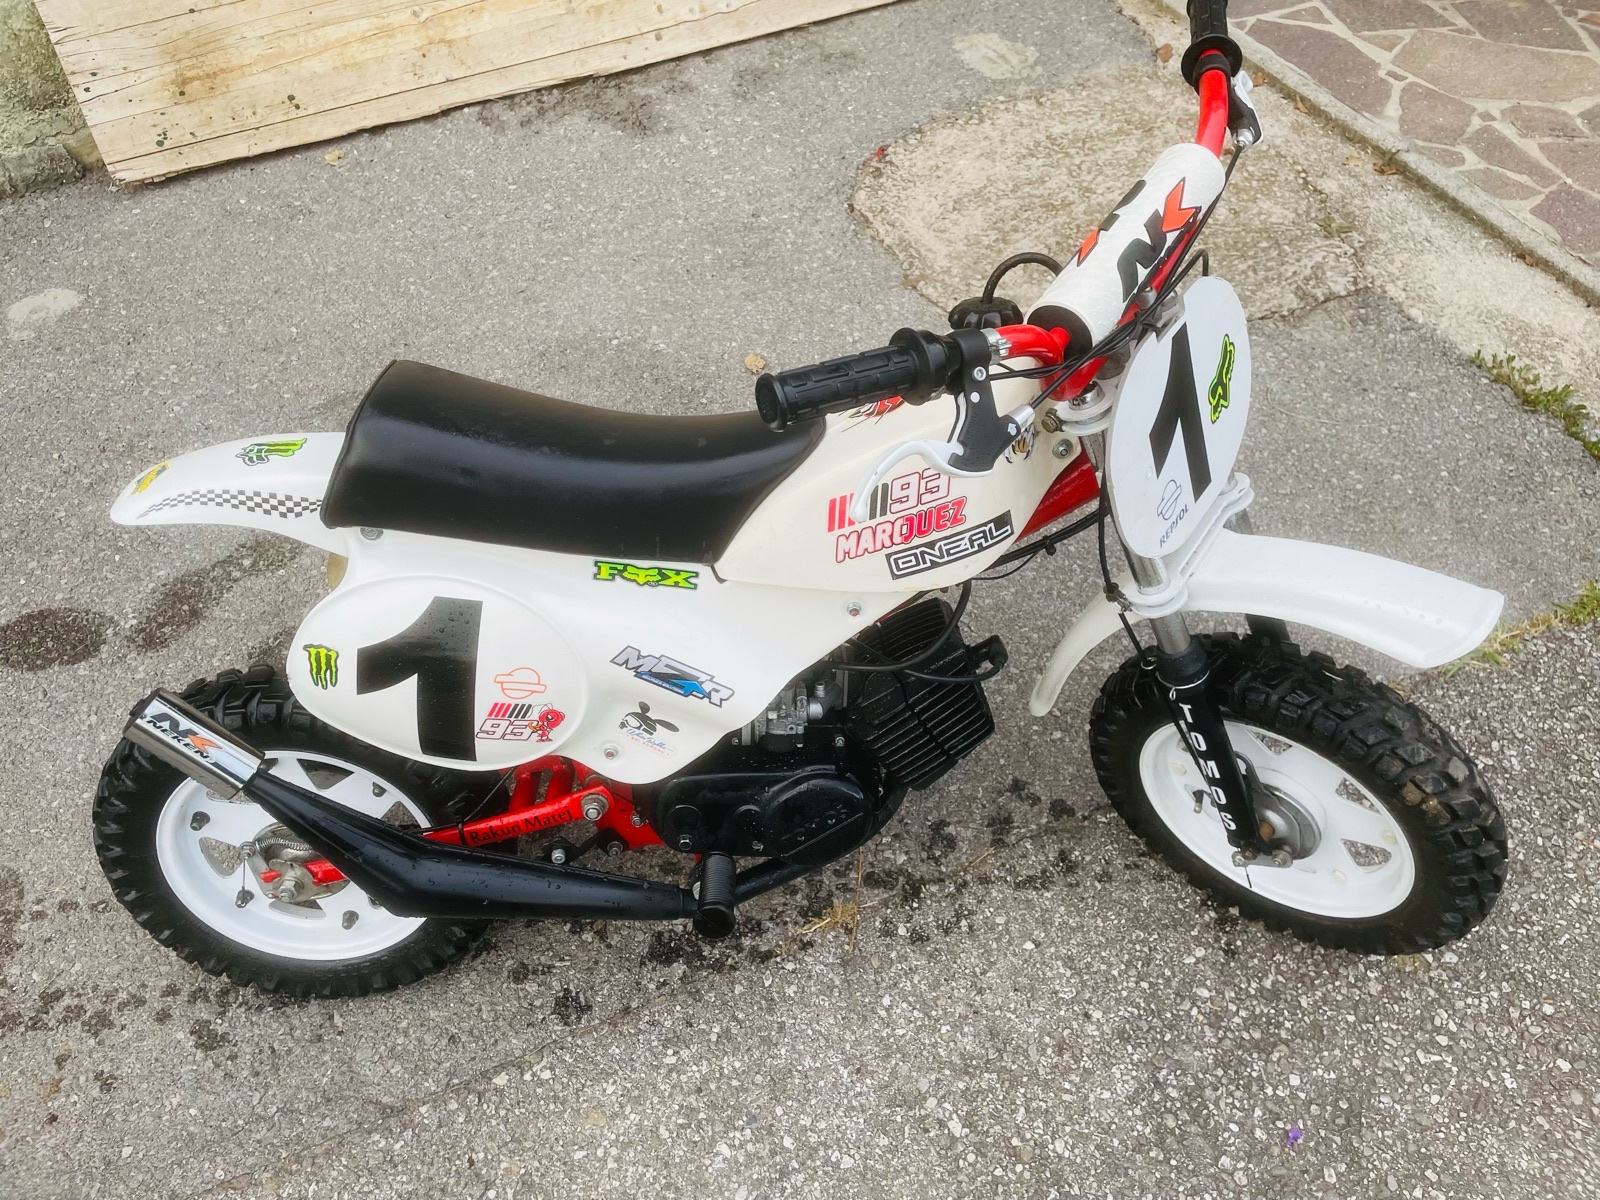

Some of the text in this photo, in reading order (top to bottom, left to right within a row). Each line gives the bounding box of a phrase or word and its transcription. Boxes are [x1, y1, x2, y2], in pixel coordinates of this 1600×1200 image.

[1149, 321, 1212, 504] 1
[889, 467, 951, 514] 93
[835, 496, 967, 563] MARQUEZ
[1159, 503, 1190, 548] REPSOL
[357, 596, 483, 762] 1
[146, 719, 210, 760] NEKEN
[475, 718, 539, 741] 93
[1178, 703, 1237, 830] TOMOS
[469, 808, 572, 844] Rakun Matej
